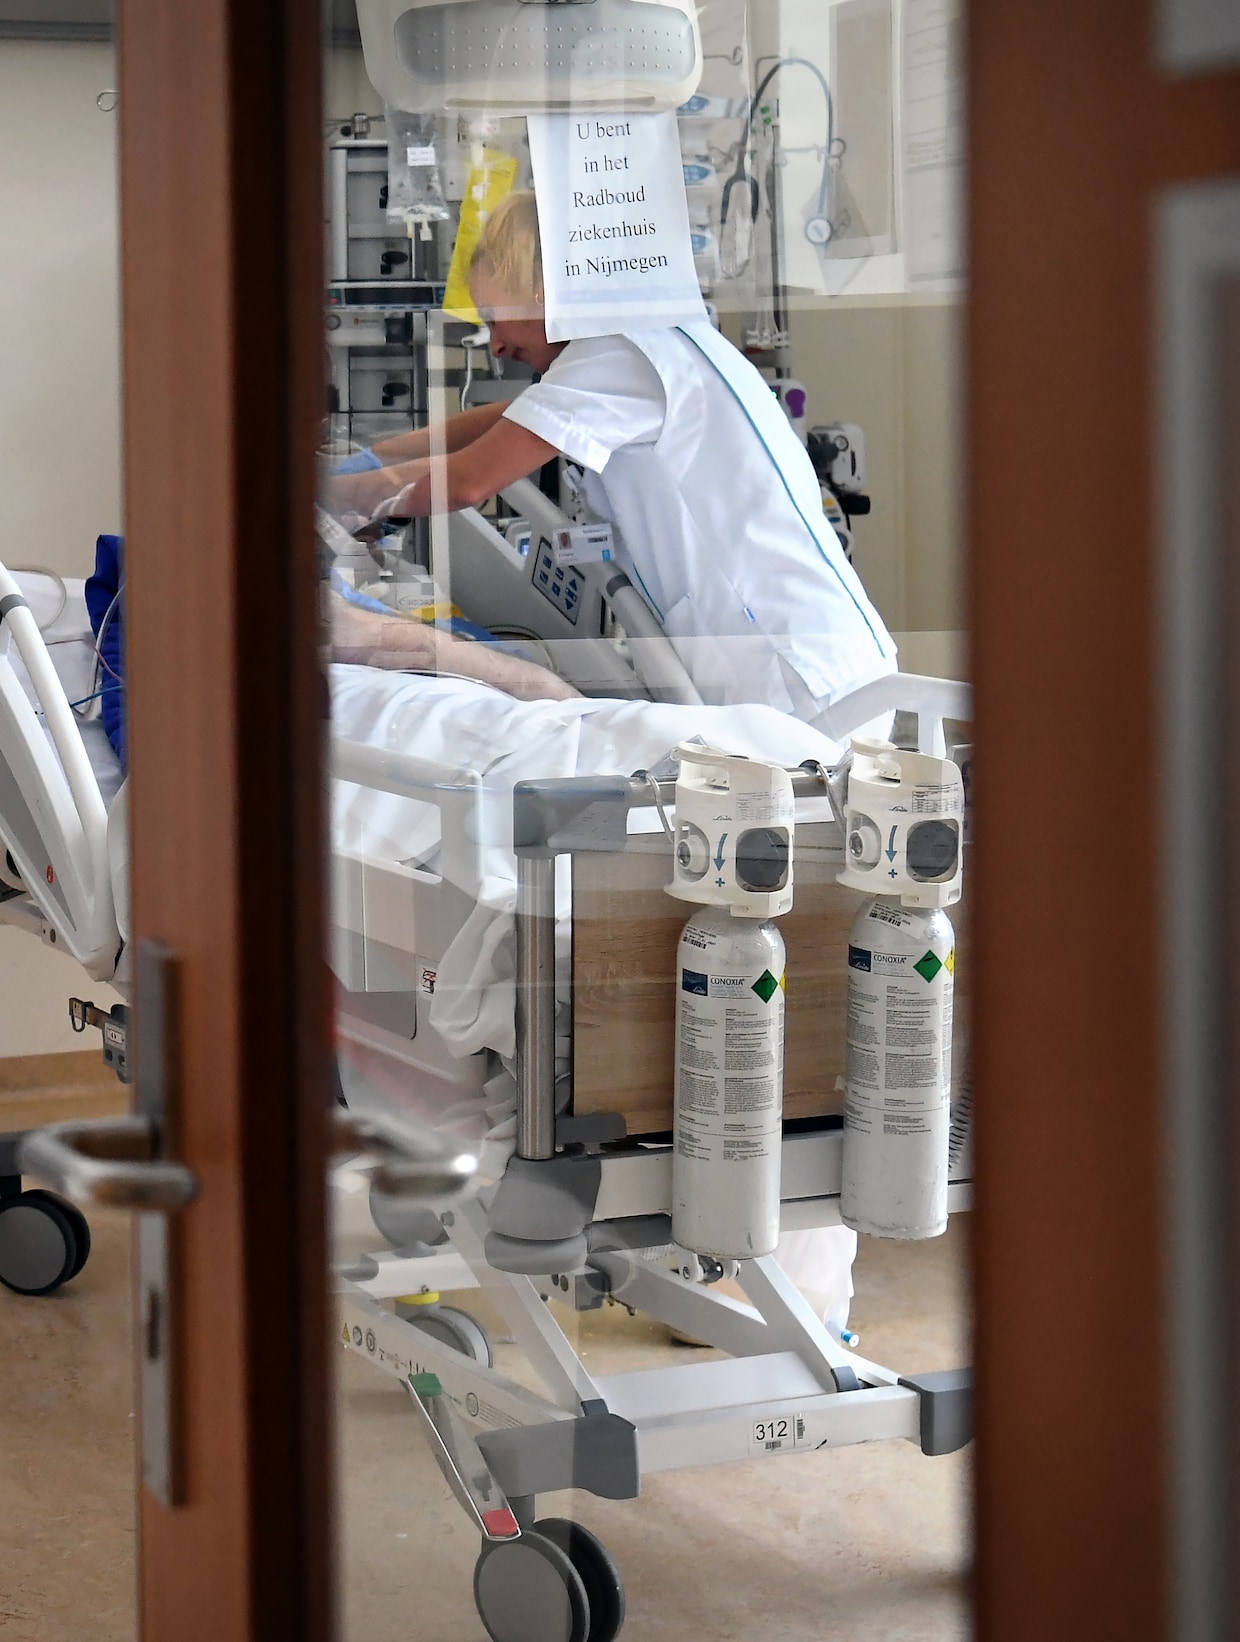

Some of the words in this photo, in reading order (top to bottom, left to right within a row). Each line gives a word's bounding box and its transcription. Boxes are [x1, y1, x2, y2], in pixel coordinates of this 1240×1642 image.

[576, 122, 591, 140] U
[596, 121, 632, 139] bent
[583, 156, 599, 174] in
[603, 154, 630, 172] het
[573, 185, 647, 209] Radboud
[568, 218, 657, 244] ziekenhuis
[565, 259, 581, 278] in
[585, 254, 669, 278] Nijmegen
[755, 1420, 788, 1441] 312
